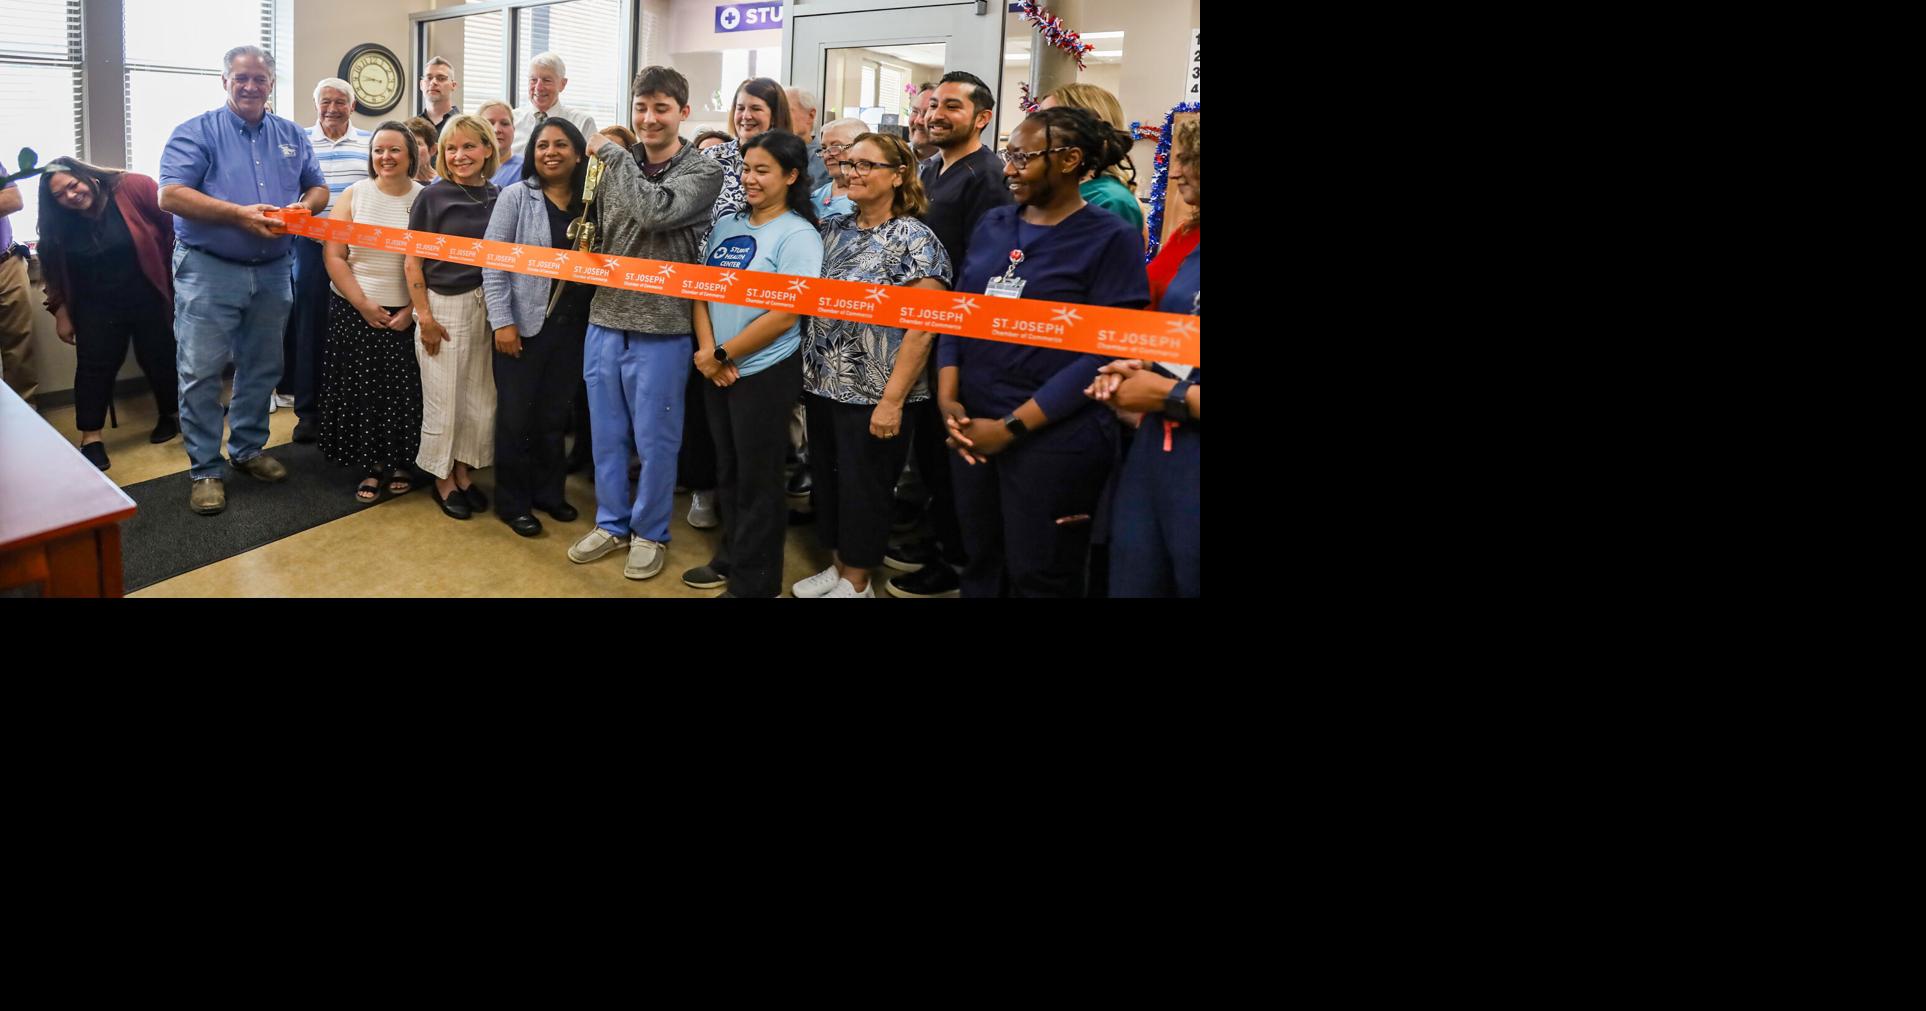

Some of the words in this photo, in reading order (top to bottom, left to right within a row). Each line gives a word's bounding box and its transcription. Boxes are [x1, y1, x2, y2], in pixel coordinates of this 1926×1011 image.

[745, 6, 783, 24] STU
[1194, 50, 1200, 62] 2
[1192, 67, 1200, 79] 3
[1191, 84, 1199, 93] 4
[495, 254, 516, 263] JOSEPH
[537, 260, 560, 269] JOSEPH
[584, 267, 609, 277] JOSEPH
[636, 273, 664, 284] JOSEPH
[694, 282, 727, 292] JOSEPH
[760, 290, 796, 301] JOSEPH
[833, 298, 874, 311] JOSEPH
[917, 309, 963, 322] JOSEPH
[1011, 320, 1064, 335] JOSEPH
[1120, 333, 1181, 348] JOSEPH
